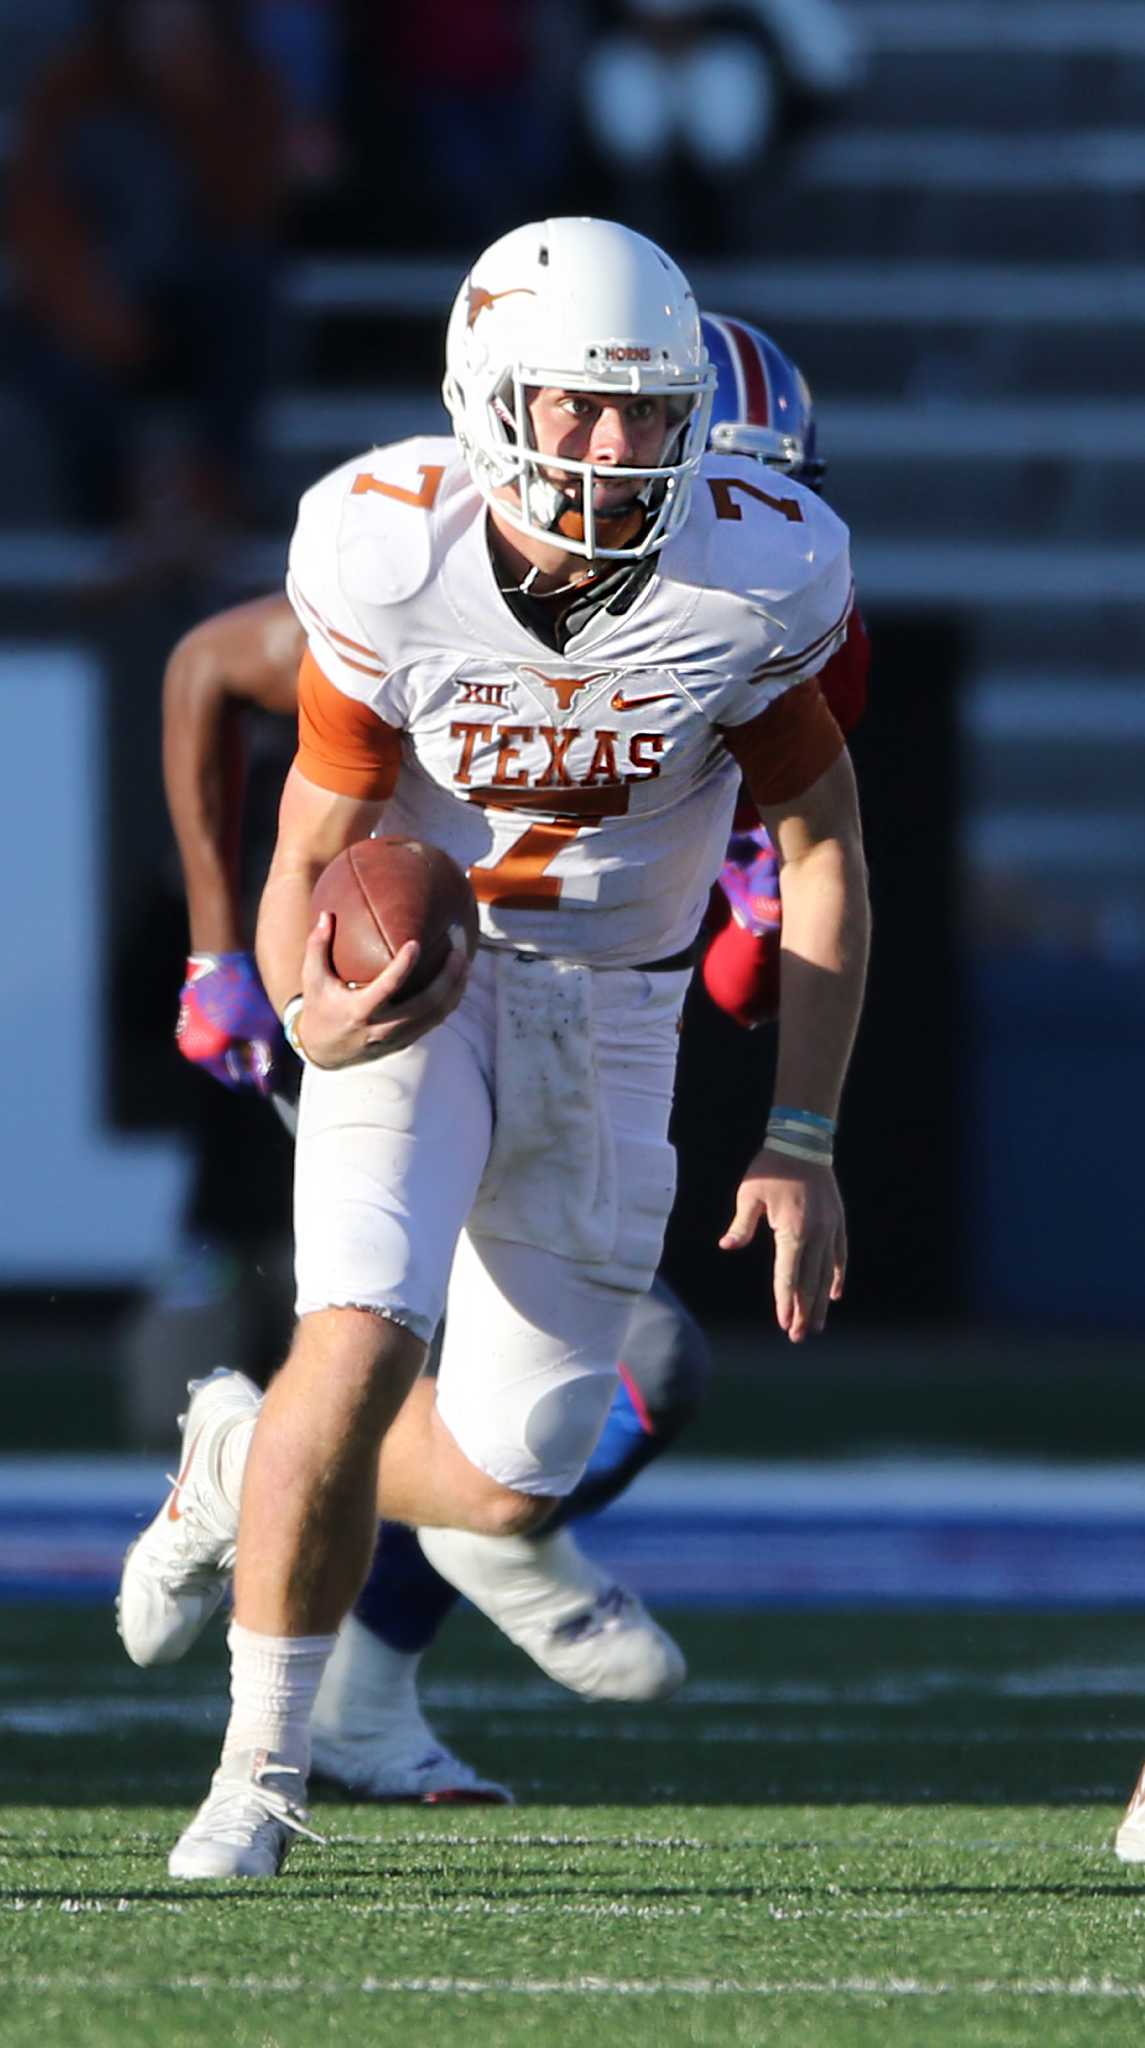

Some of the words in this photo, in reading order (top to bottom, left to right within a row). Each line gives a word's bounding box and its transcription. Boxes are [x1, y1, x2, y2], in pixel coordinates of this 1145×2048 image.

[605, 346, 651, 361] HORNS
[351, 464, 447, 511] 7
[706, 478, 804, 522] 7
[450, 721, 665, 787] TEXAS
[466, 786, 631, 911] 7
